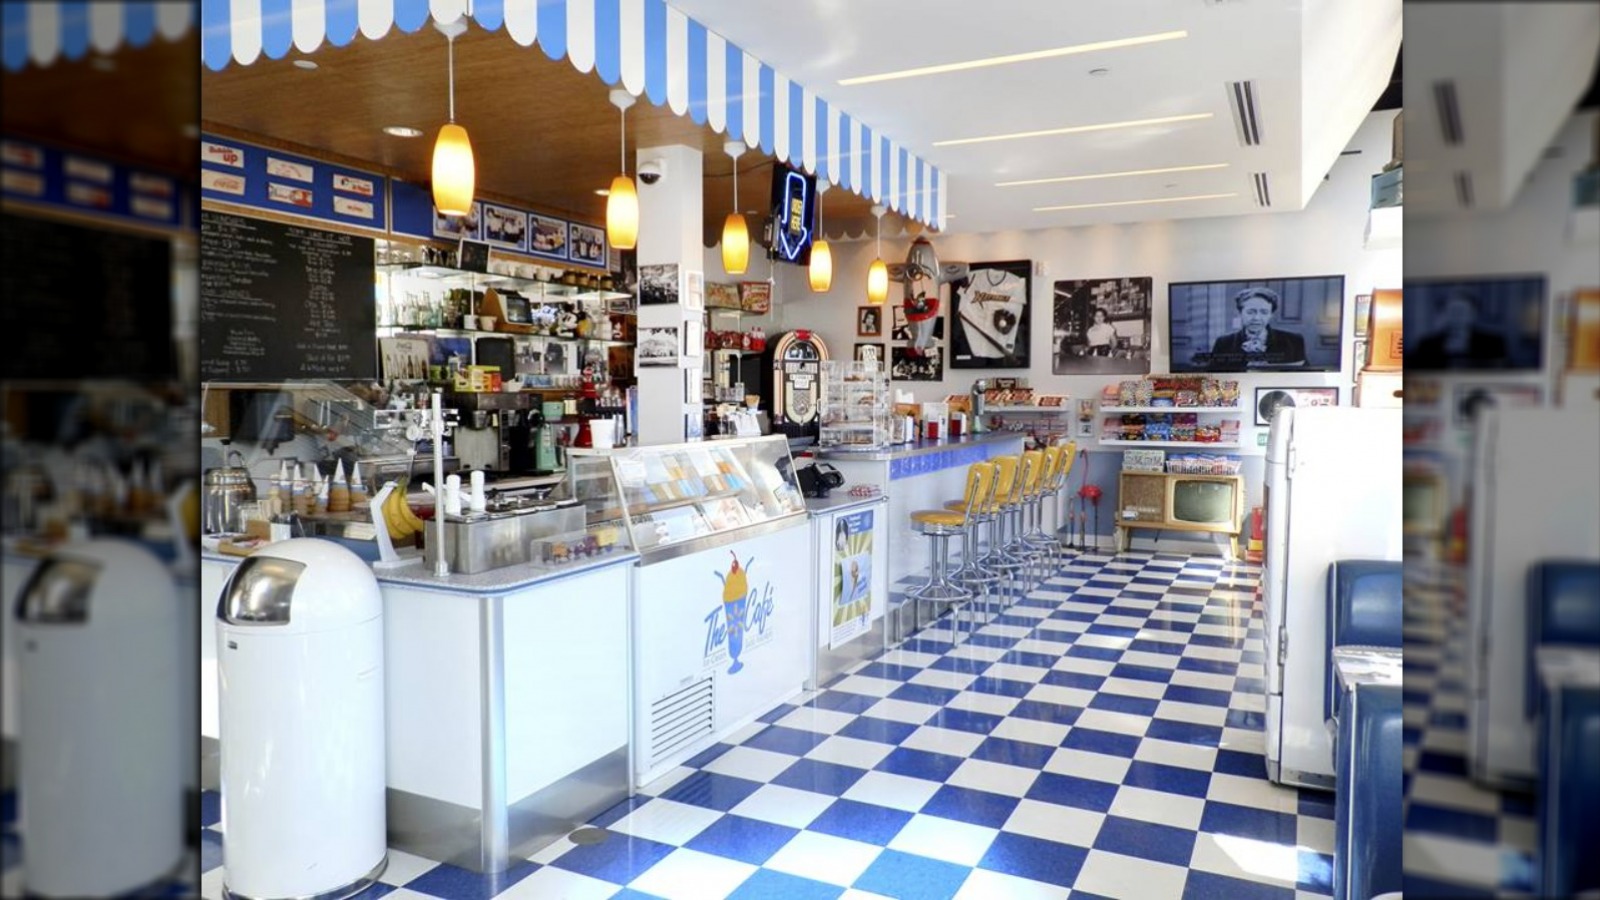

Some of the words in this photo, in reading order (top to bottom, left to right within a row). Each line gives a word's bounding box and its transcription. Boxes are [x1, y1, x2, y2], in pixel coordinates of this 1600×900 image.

[223, 153, 238, 165] up
[704, 605, 728, 657] The
[744, 581, 774, 634] Café
